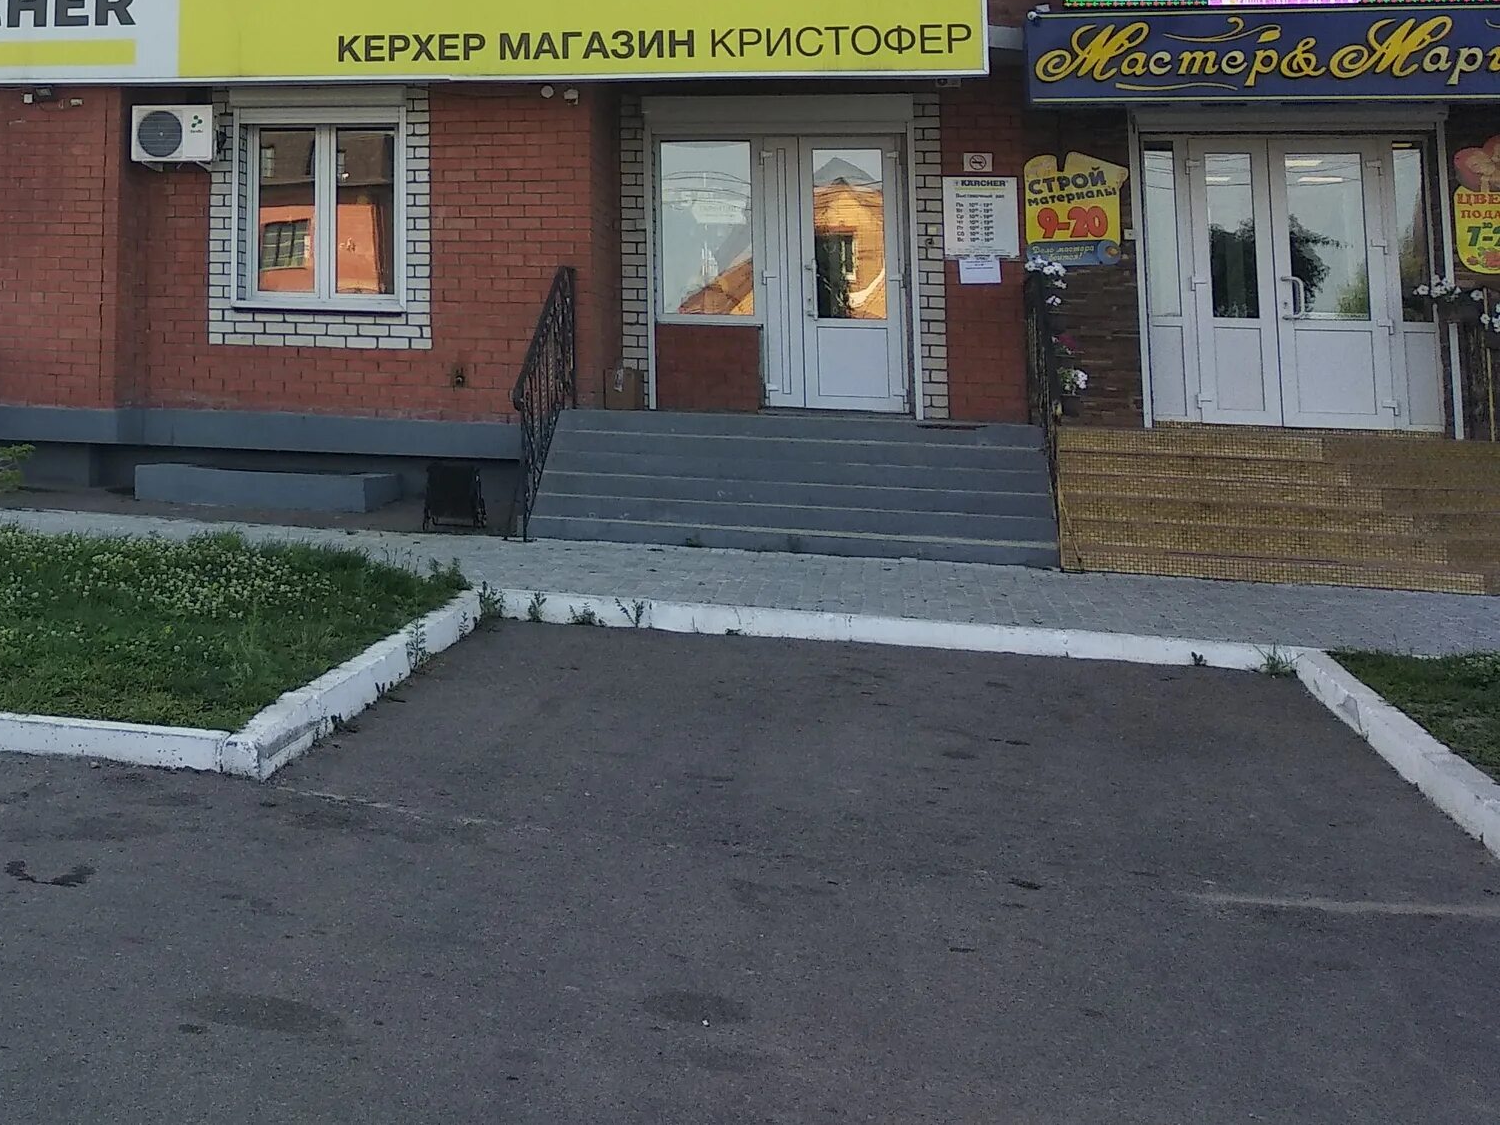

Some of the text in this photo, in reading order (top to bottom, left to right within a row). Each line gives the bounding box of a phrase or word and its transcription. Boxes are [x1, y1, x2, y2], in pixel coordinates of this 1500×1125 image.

[336, 22, 972, 63] КЕРХЕР МАГАЗИН КРИСТОФЕР
[1028, 166, 1107, 194] СТРОЙ
[1027, 187, 1117, 207] материалы
[1037, 206, 1109, 239] 9-20
